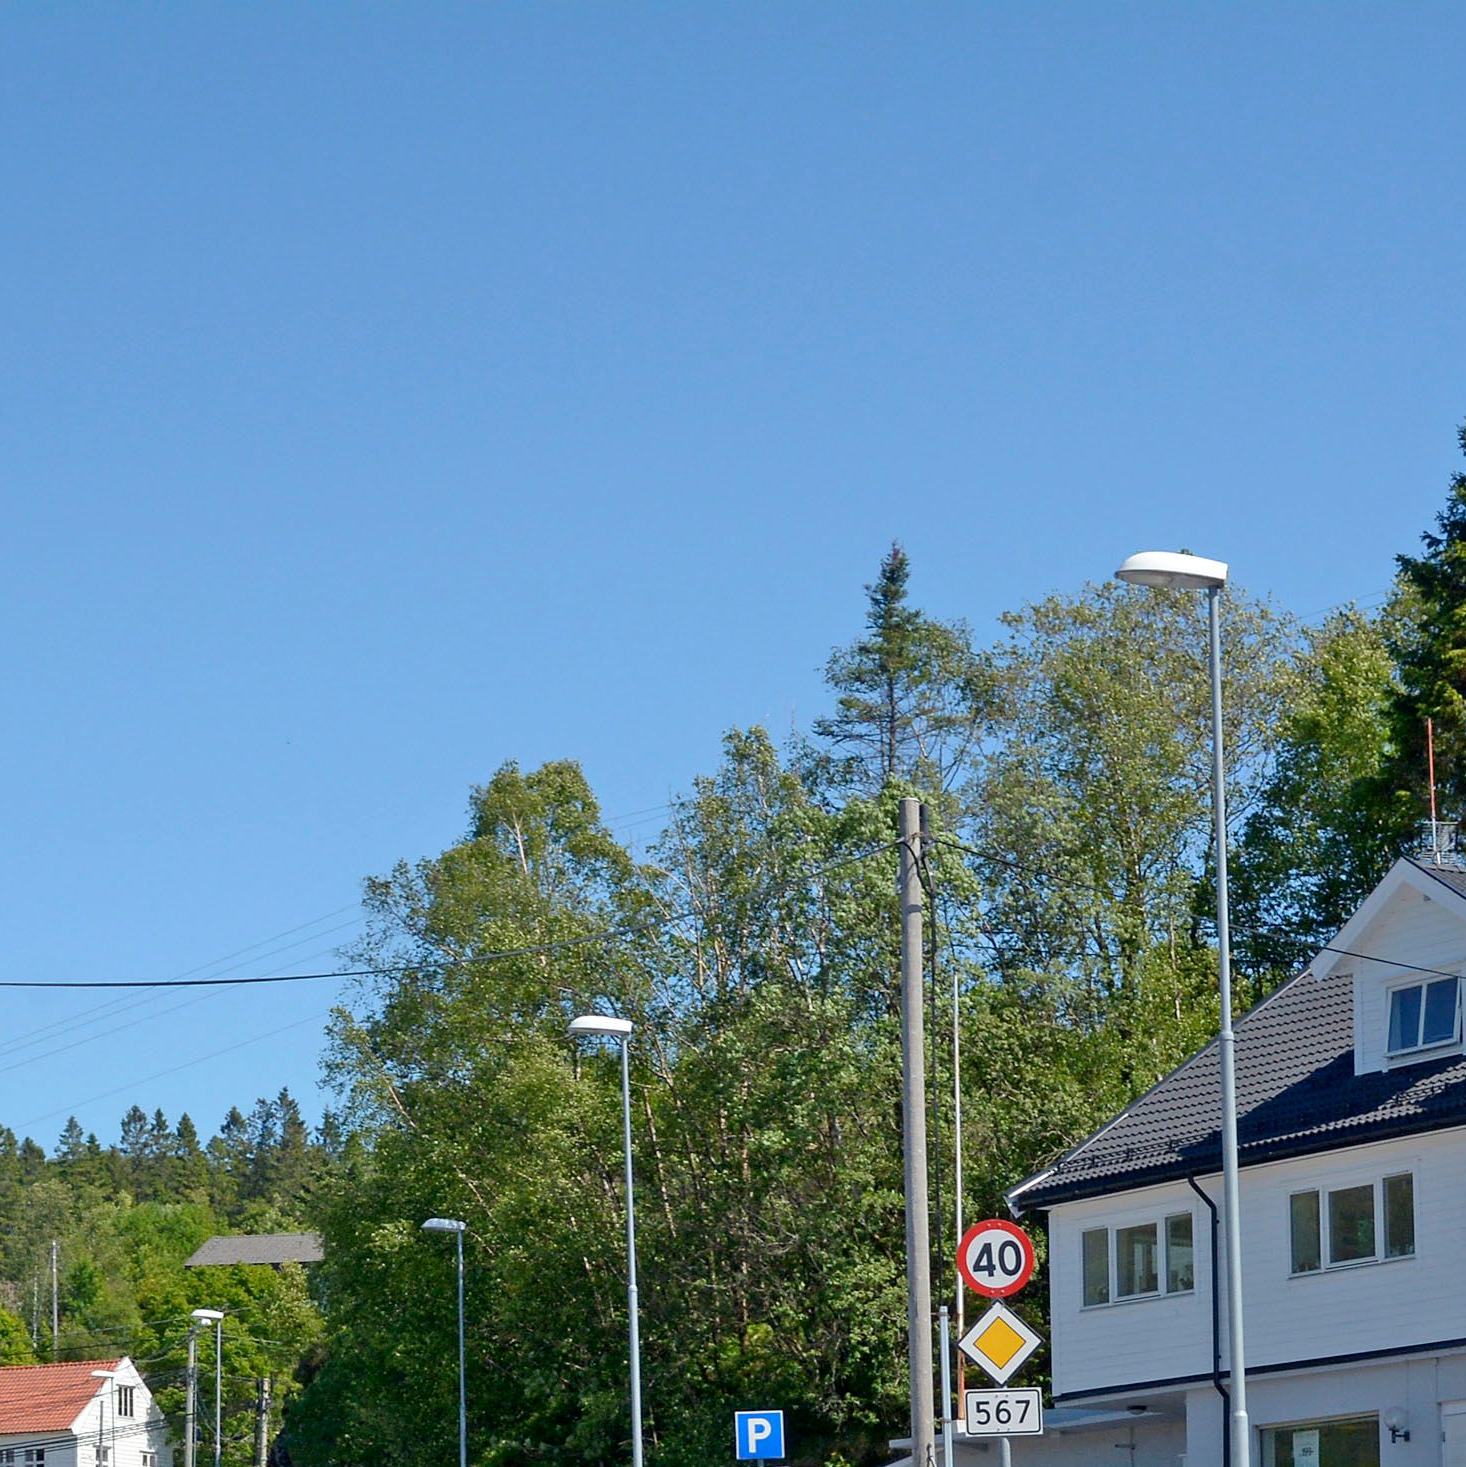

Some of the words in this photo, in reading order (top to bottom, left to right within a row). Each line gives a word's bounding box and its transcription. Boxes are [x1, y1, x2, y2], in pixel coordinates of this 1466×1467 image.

[972, 1239, 1022, 1277] 40
[975, 1399, 1031, 1425] 567
[747, 1417, 772, 1454] P
